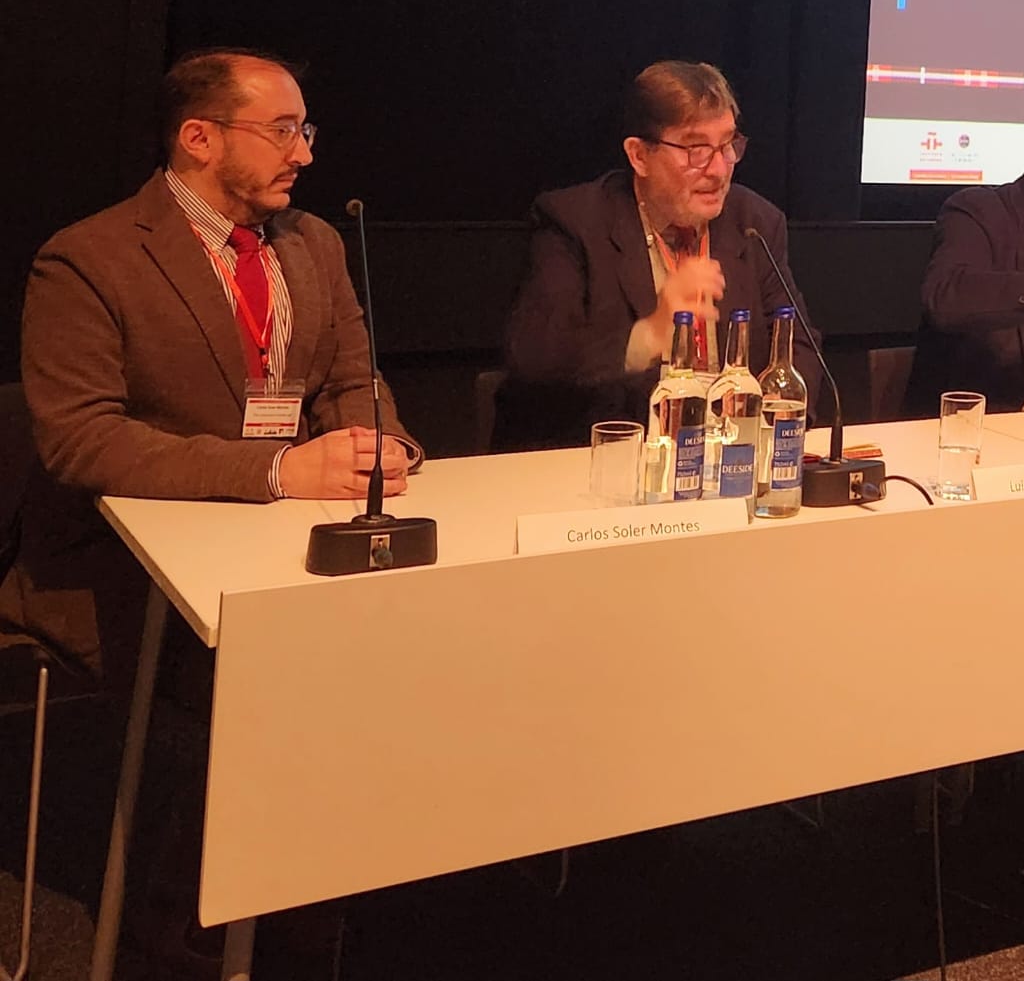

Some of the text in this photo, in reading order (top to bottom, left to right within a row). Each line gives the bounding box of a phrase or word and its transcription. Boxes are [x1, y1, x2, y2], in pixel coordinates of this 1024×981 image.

[567, 521, 700, 542] Carlos Soler Montes
